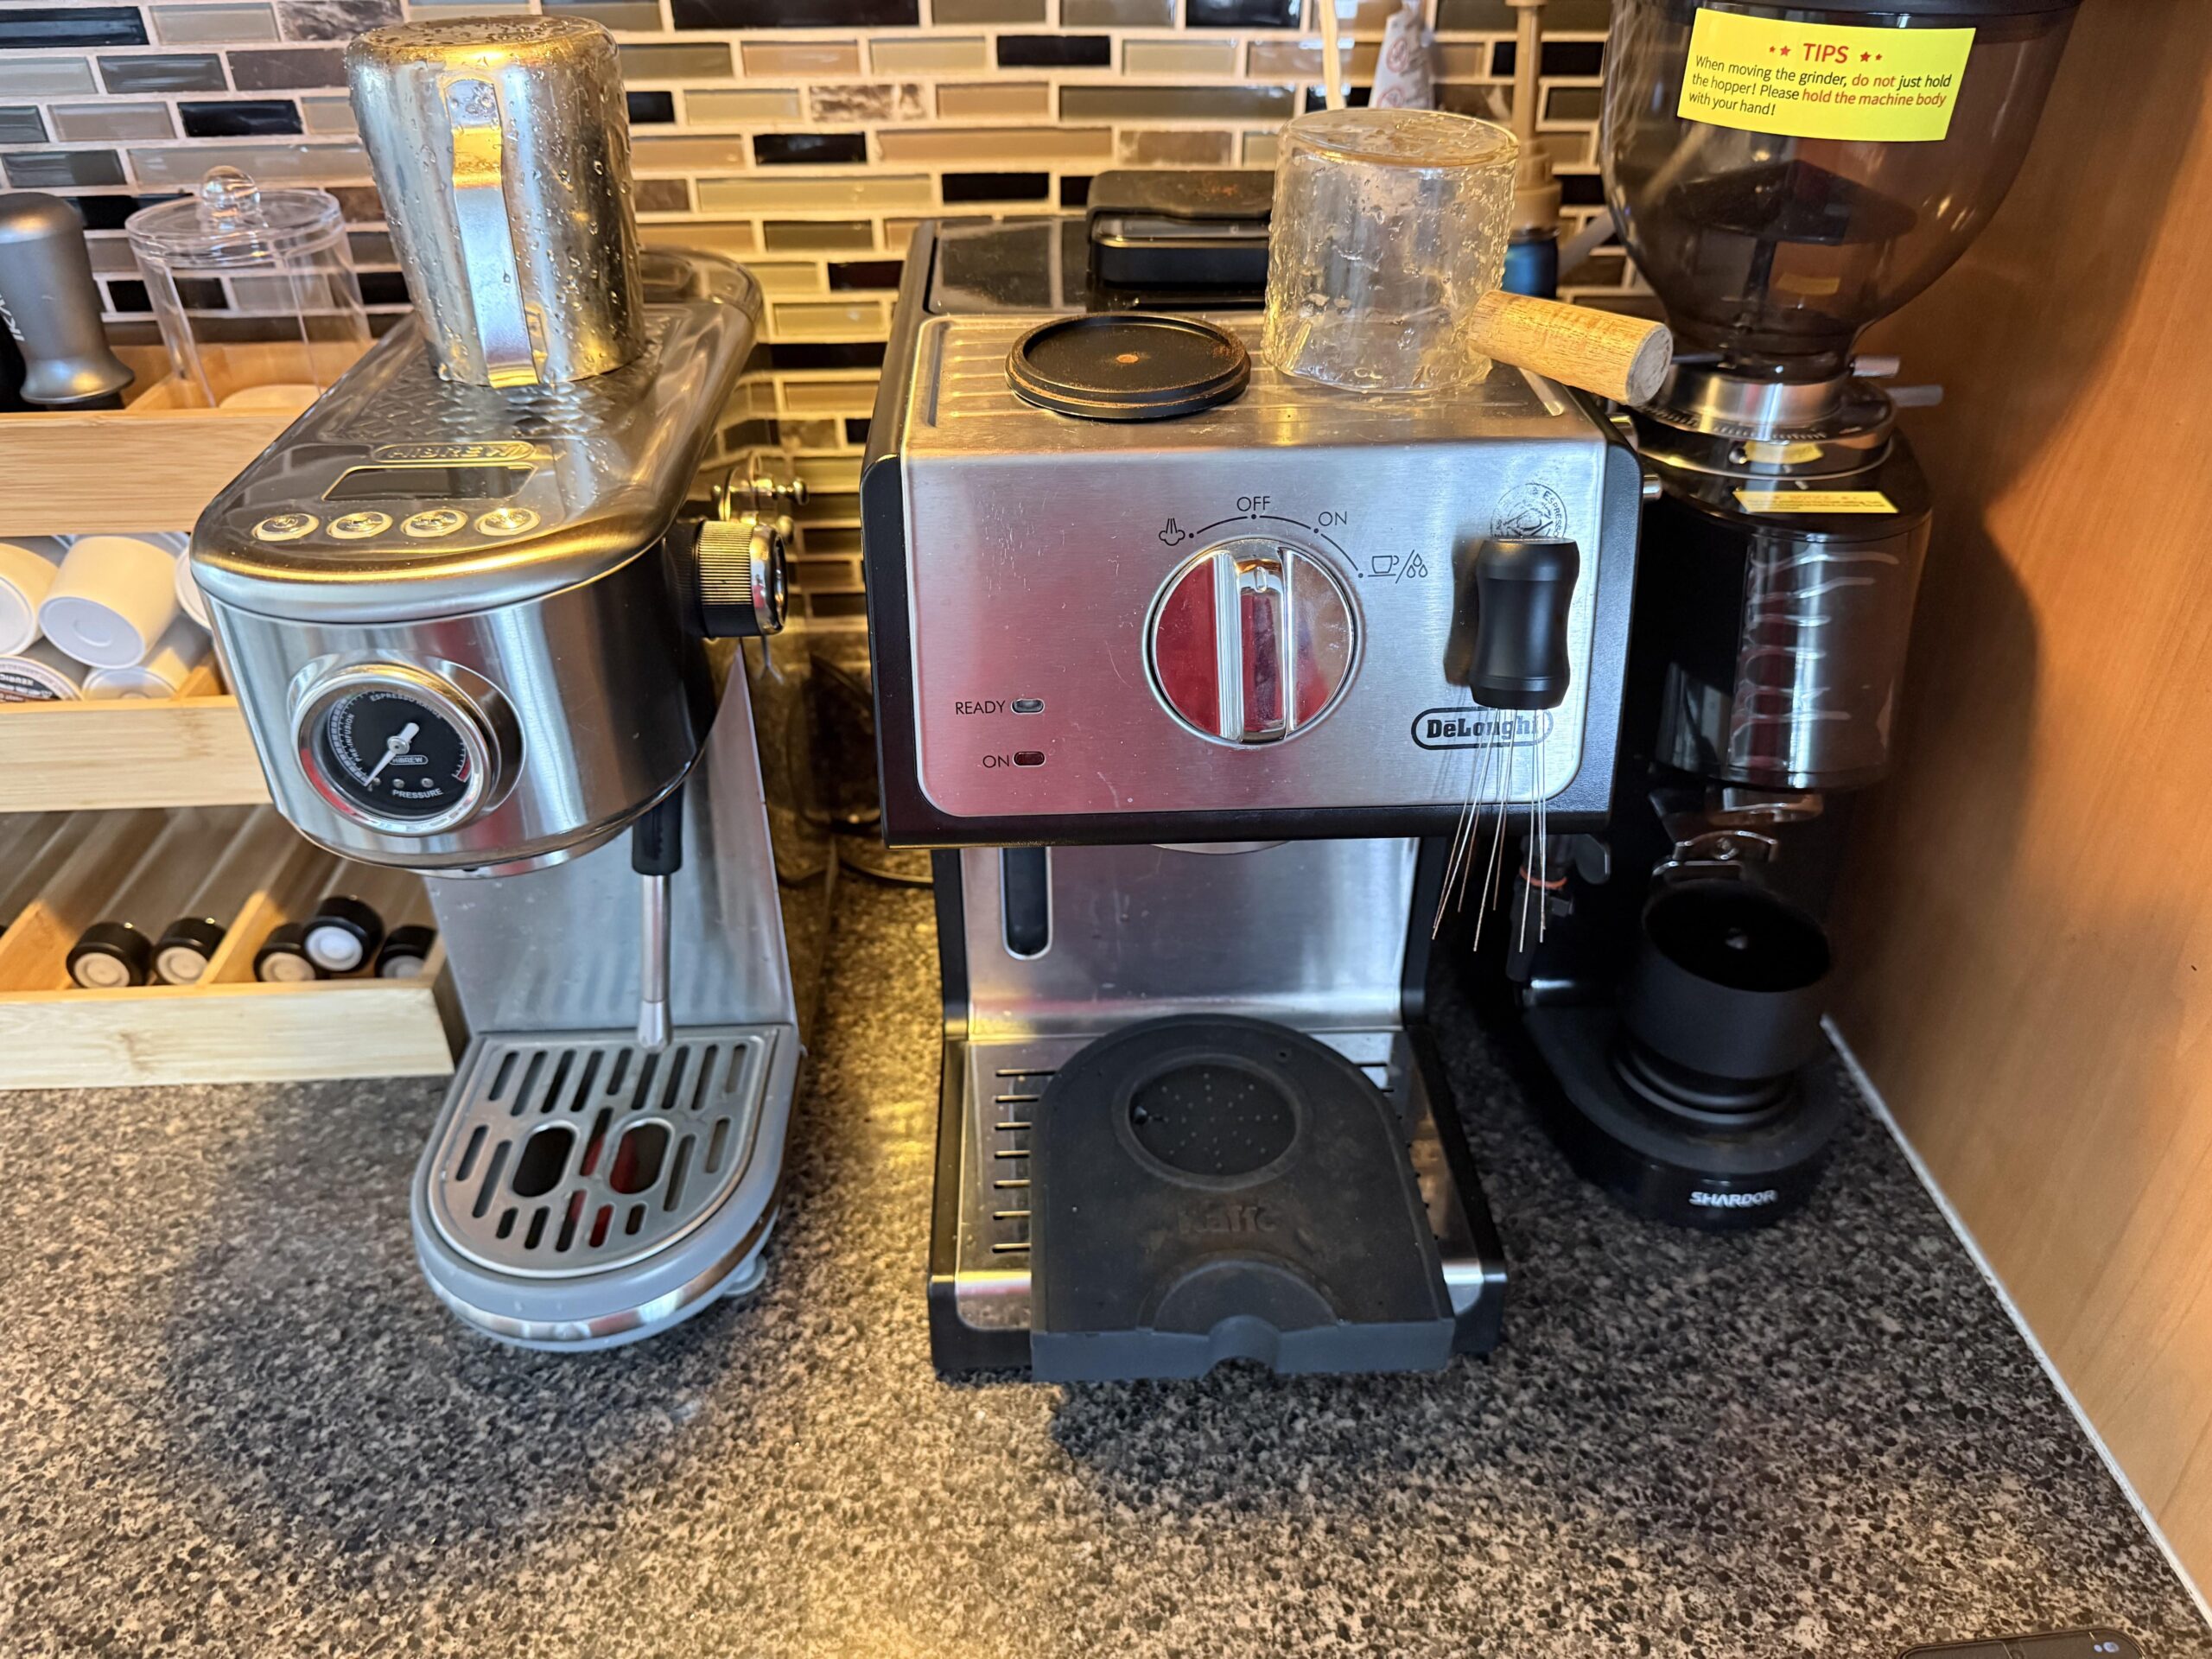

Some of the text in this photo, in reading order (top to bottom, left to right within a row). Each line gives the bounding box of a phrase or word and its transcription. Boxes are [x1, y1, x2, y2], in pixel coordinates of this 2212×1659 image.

[1803, 42, 1849, 64] TIPS
[1696, 54, 1952, 91] When moving the grinder, do not just hold
[1692, 73, 1947, 108] the hopper! Please hold the machine body
[1688, 92, 1777, 116] with your hand!
[1236, 496, 1270, 512] OFF
[1318, 511, 1347, 527] ON
[955, 700, 1006, 715] READY
[982, 754, 1010, 768] ON
[391, 787, 444, 799] PRESSURE
[1688, 1189, 1778, 1208] SHARDOR
